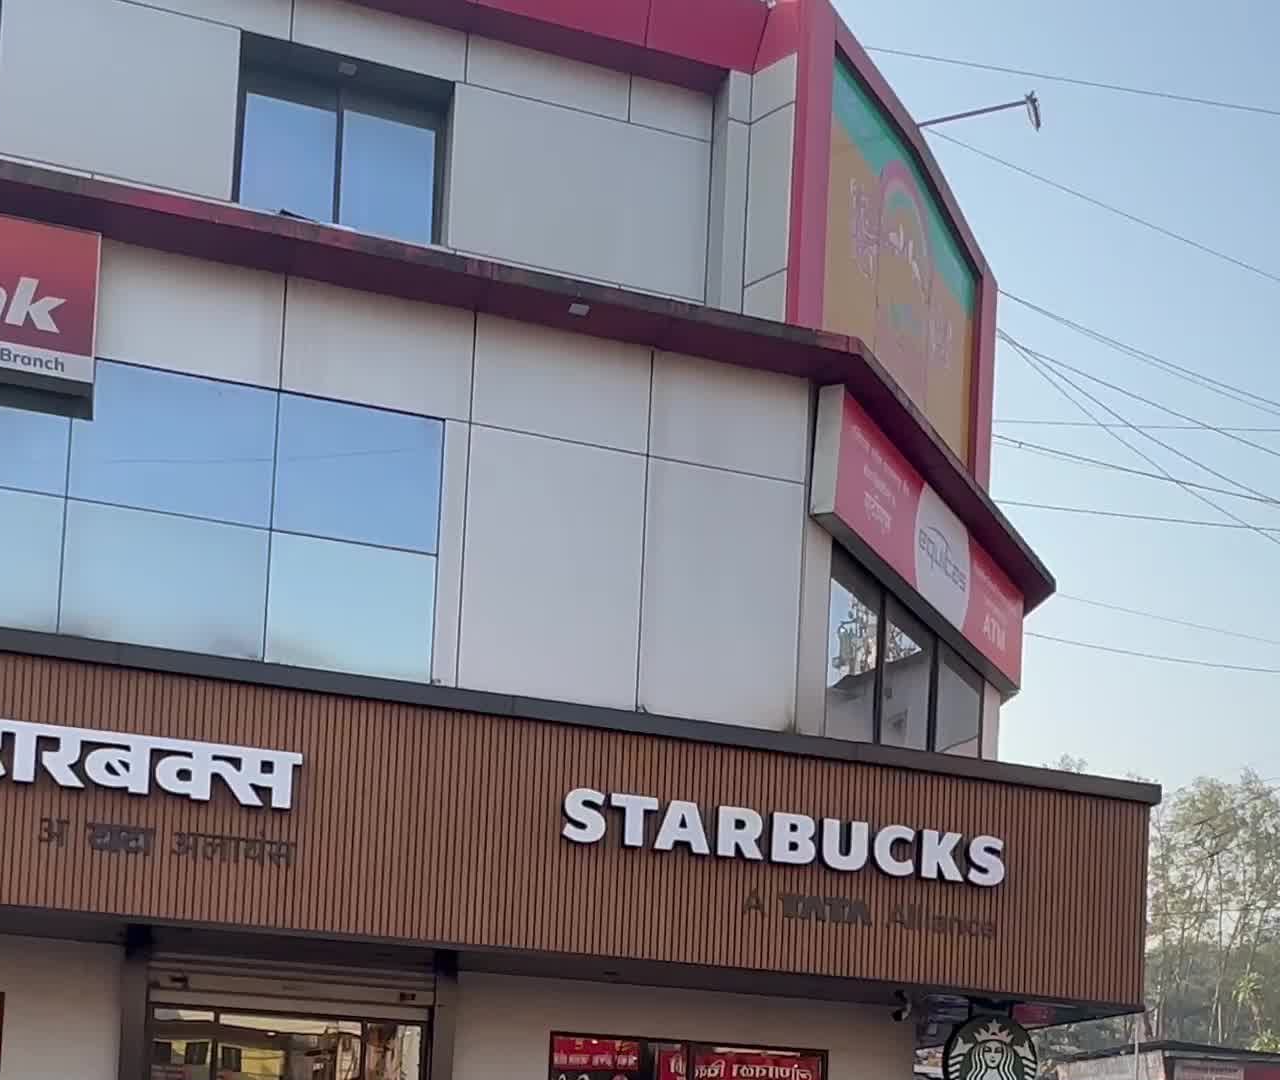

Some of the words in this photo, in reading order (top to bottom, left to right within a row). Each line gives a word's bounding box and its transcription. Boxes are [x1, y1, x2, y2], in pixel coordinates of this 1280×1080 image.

[0, 347, 65, 373] Branch
[561, 787, 1006, 888] STARBUCKS
[743, 891, 767, 917] A
[779, 892, 873, 928] TATA
